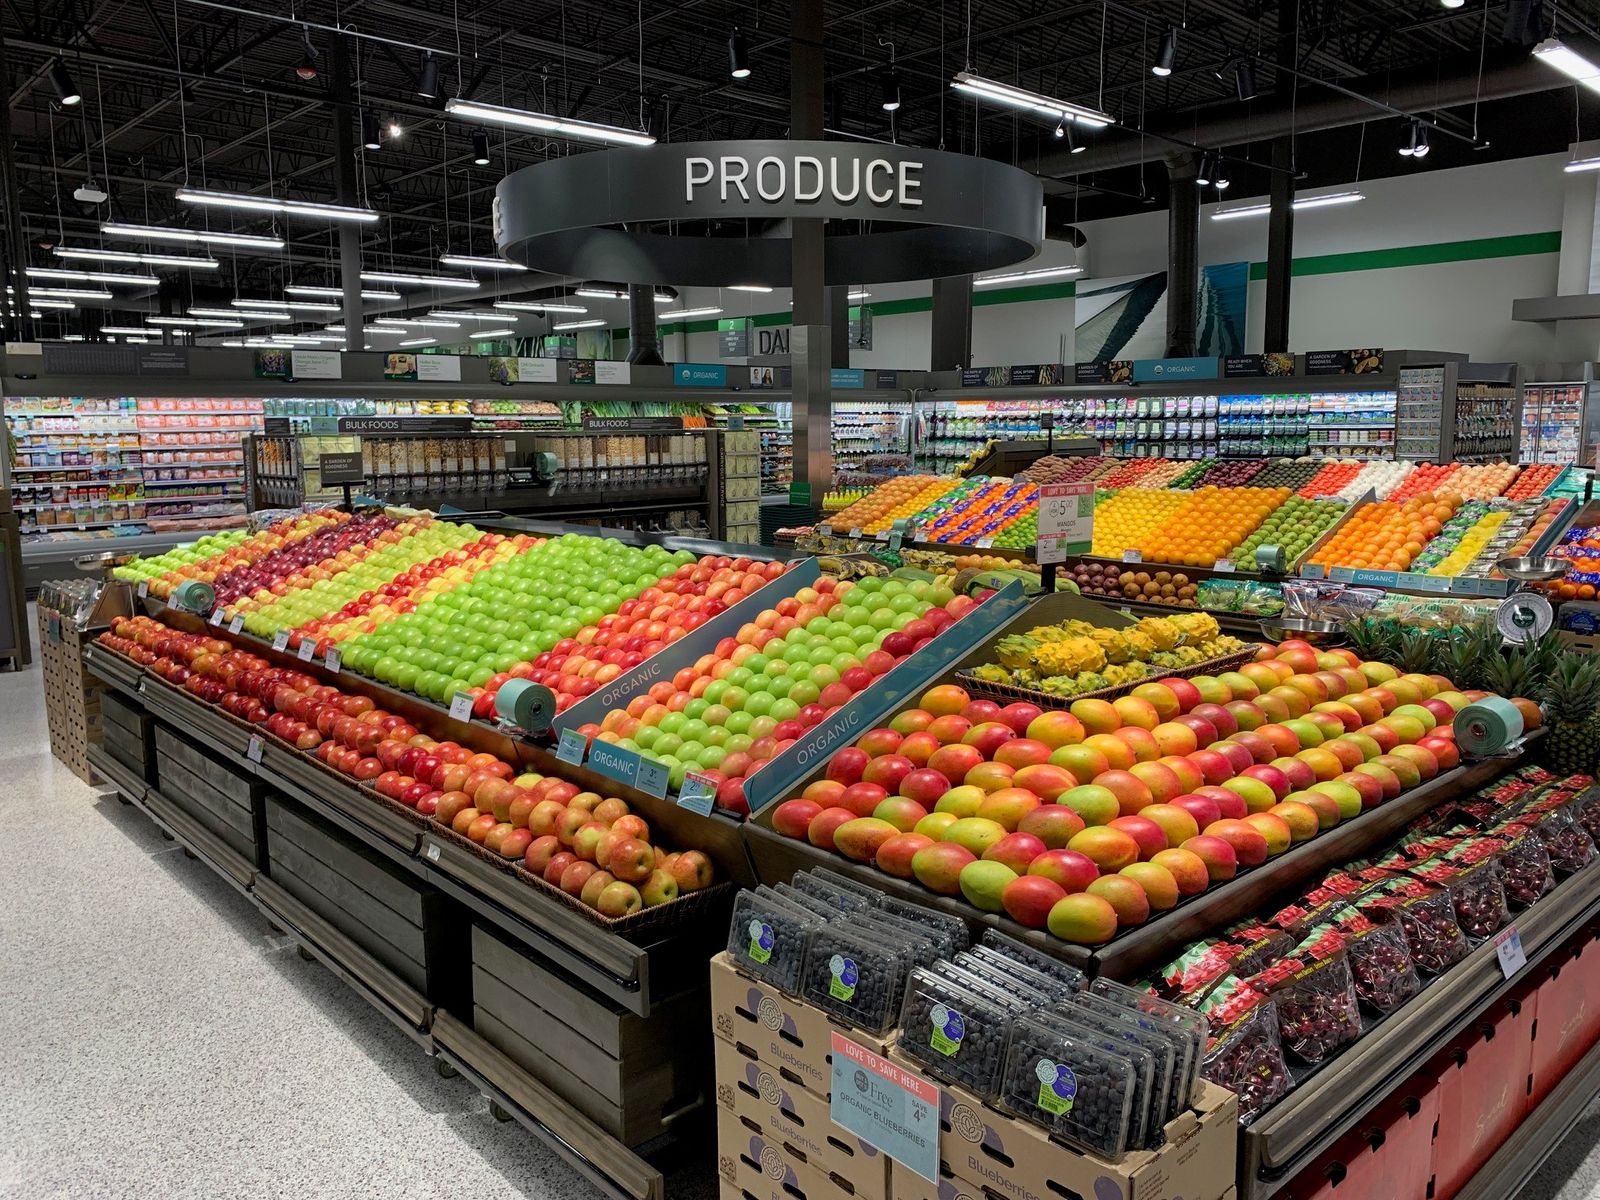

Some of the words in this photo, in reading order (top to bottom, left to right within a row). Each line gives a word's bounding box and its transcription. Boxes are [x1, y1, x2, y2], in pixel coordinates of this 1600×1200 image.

[685, 156, 924, 206] PRODUCE
[729, 320, 735, 330] 2
[693, 371, 719, 380] ORGANIC
[1167, 365, 1196, 373] ORGANIC
[345, 420, 368, 430] BULK
[368, 420, 399, 430] FOODS
[589, 420, 606, 428] BULK
[606, 420, 629, 428] FOODS
[1358, 574, 1394, 583] ORGANIC
[602, 663, 662, 707] ORGANIC
[797, 712, 858, 764] ORGANIC
[594, 750, 634, 776] ORGANIC
[770, 1042, 824, 1082] Blueberries
[845, 1043, 864, 1062] LOVE
[866, 1056, 876, 1068] TO
[880, 1062, 898, 1080] SAVE
[900, 1074, 923, 1095] HERE.
[870, 1081, 894, 1108] Free
[912, 1100, 928, 1114] SAVE
[840, 1091, 872, 1117] ORGANIC
[873, 1111, 926, 1149] BLUEBERRIES
[770, 1115, 823, 1157] Blueberries
